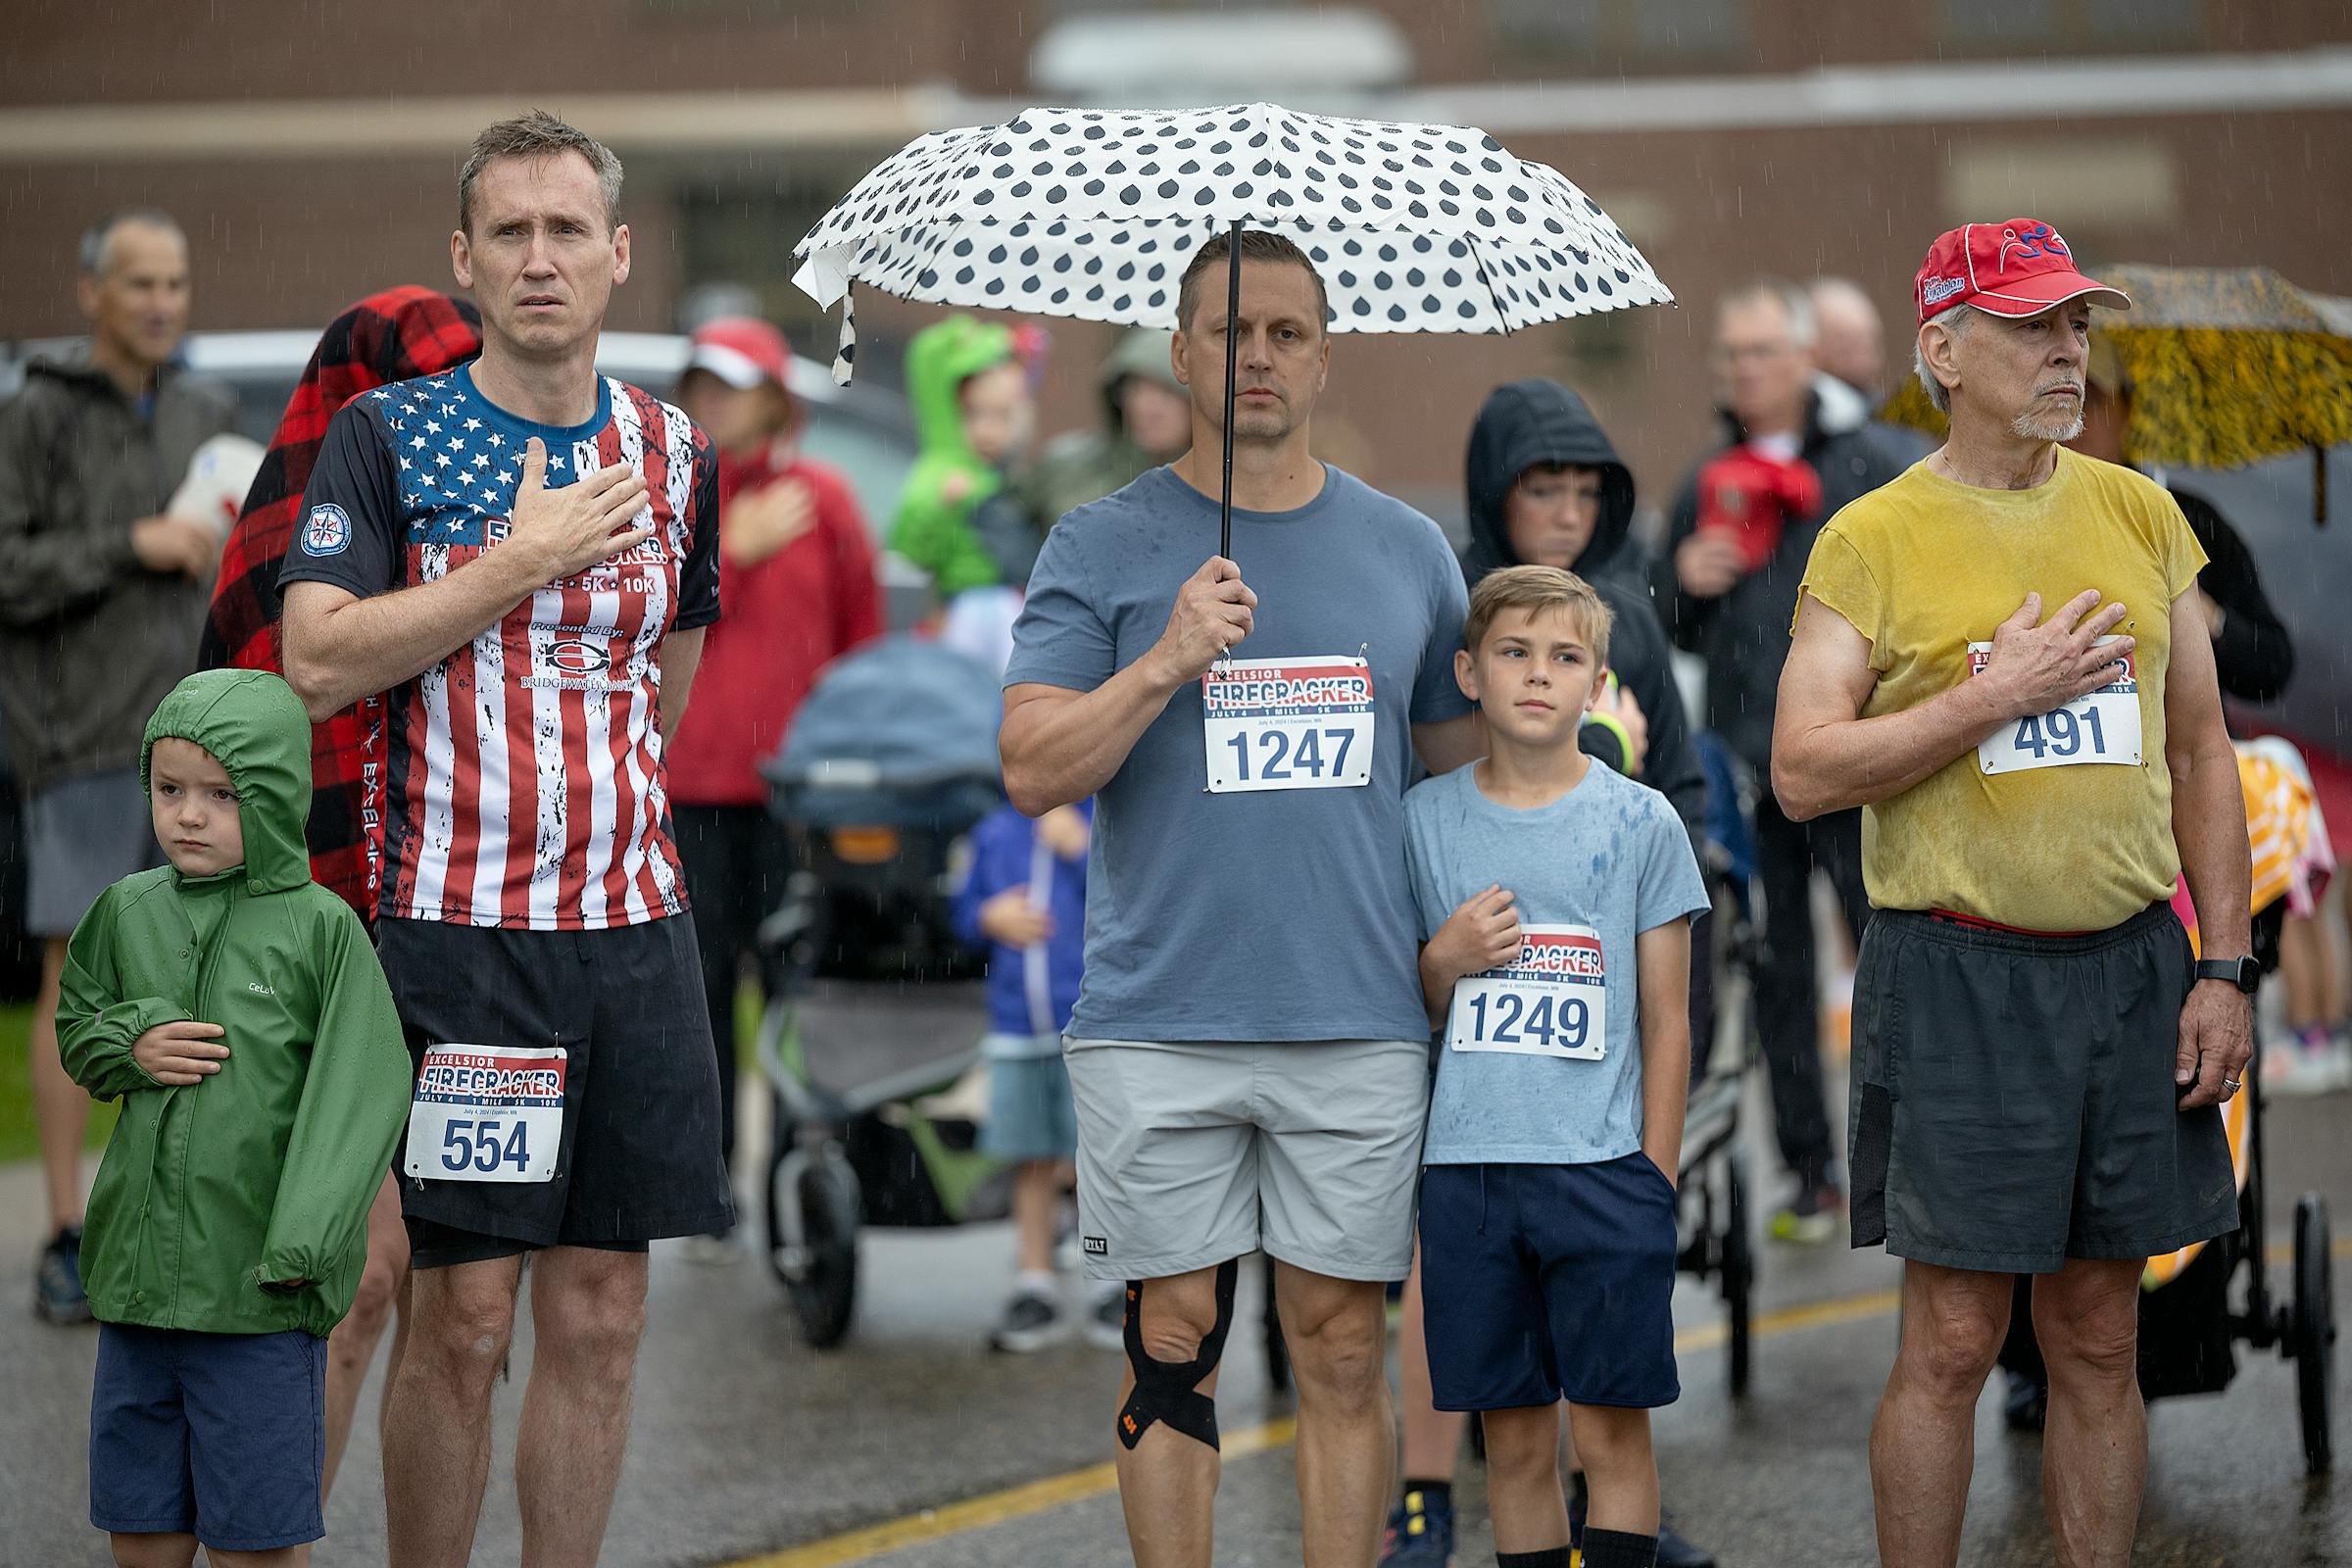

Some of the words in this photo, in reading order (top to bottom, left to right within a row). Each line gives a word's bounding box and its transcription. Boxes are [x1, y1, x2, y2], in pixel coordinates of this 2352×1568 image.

[581, 576, 605, 591] 5K
[623, 577, 655, 593] 10K
[531, 621, 600, 635] Presented
[602, 625, 623, 639] By:
[521, 676, 605, 690] BRIDGEWATER
[1207, 676, 1368, 710] FIRECRACKER
[2014, 706, 2106, 759] 491
[1227, 728, 1355, 781] 1247
[1493, 944, 1603, 977] RACKER
[1470, 992, 1589, 1049] 1249
[429, 1054, 495, 1068] EXCELSIOR
[419, 1065, 563, 1099] FIRECRACKER
[419, 1094, 443, 1102] JULY
[481, 1098, 503, 1106] MILE
[540, 1099, 557, 1107] 10K
[441, 1119, 530, 1172] 554
